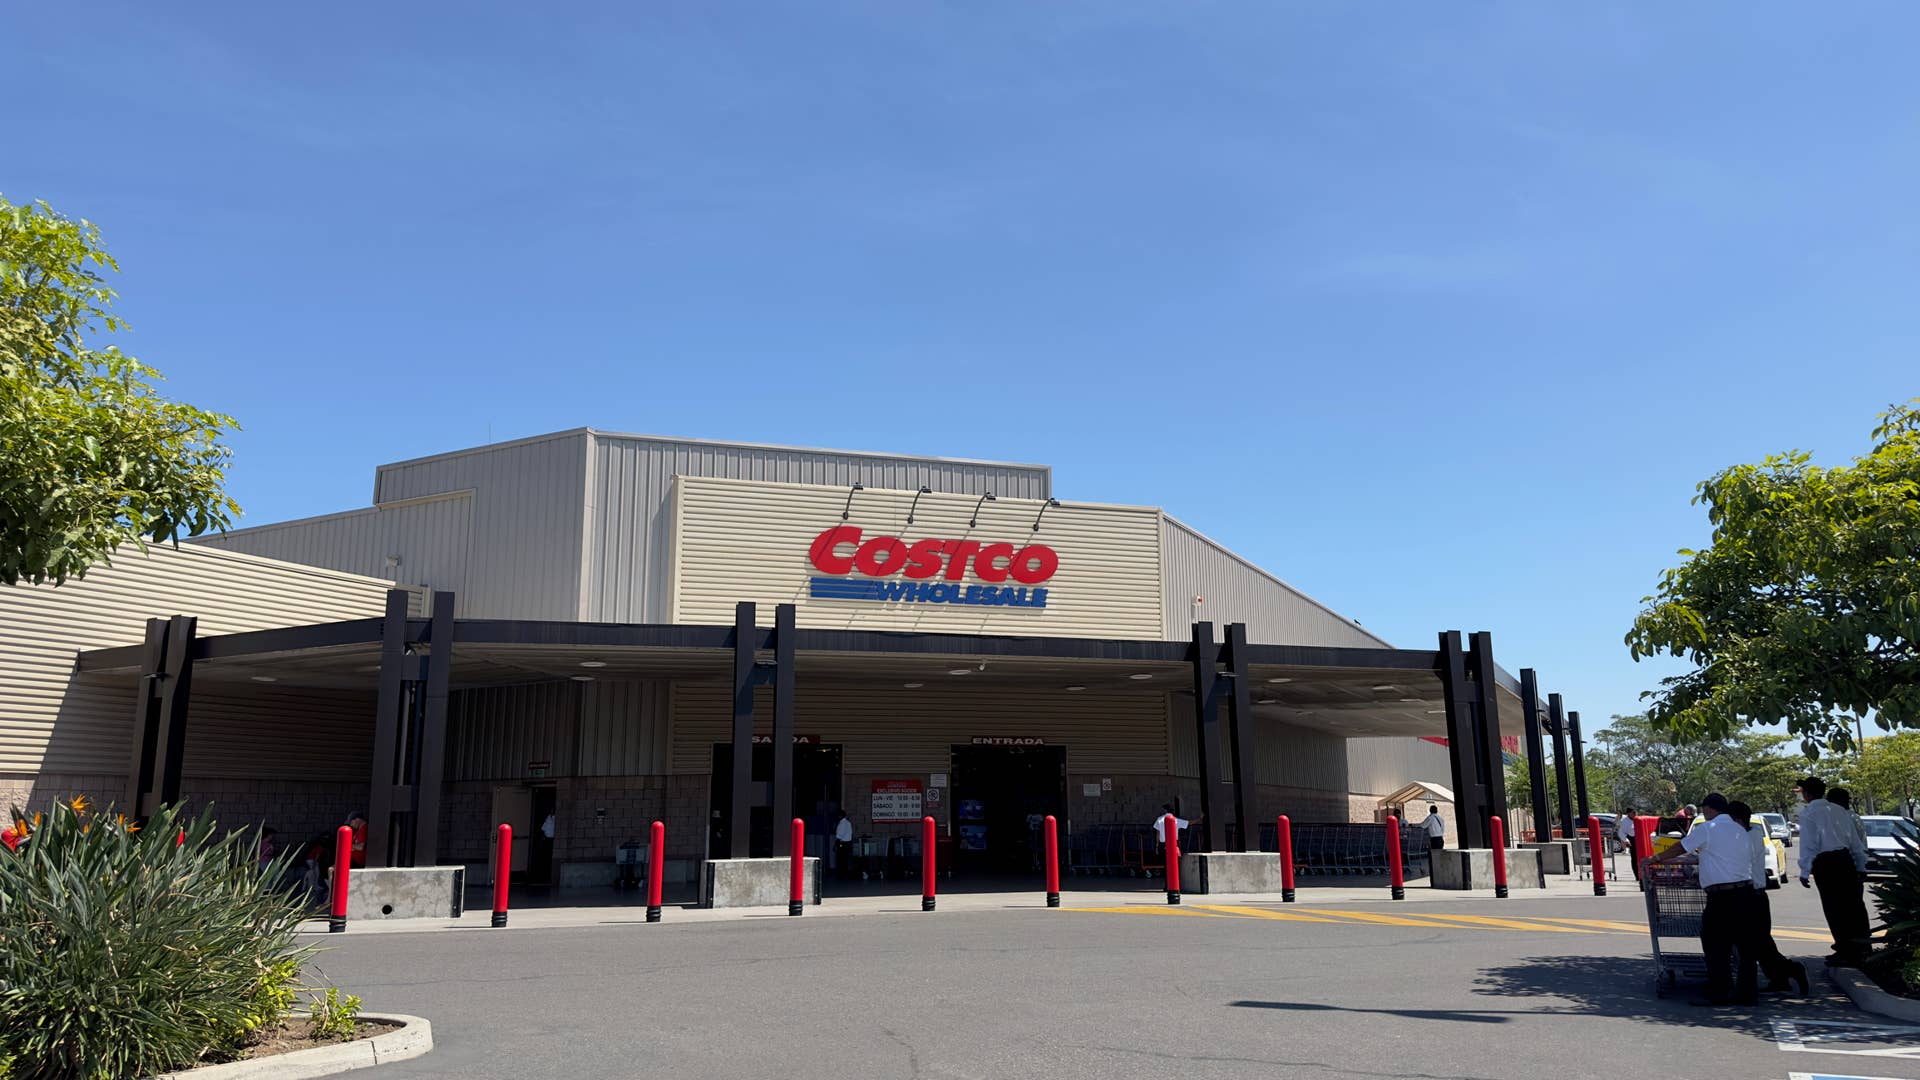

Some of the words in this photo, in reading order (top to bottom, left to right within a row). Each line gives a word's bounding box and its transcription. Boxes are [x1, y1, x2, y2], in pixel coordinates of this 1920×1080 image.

[809, 525, 1059, 584] COSTCO
[876, 581, 1049, 608] WHOLESALE
[752, 735, 809, 744] SADA
[973, 736, 1044, 745] ENTRADA
